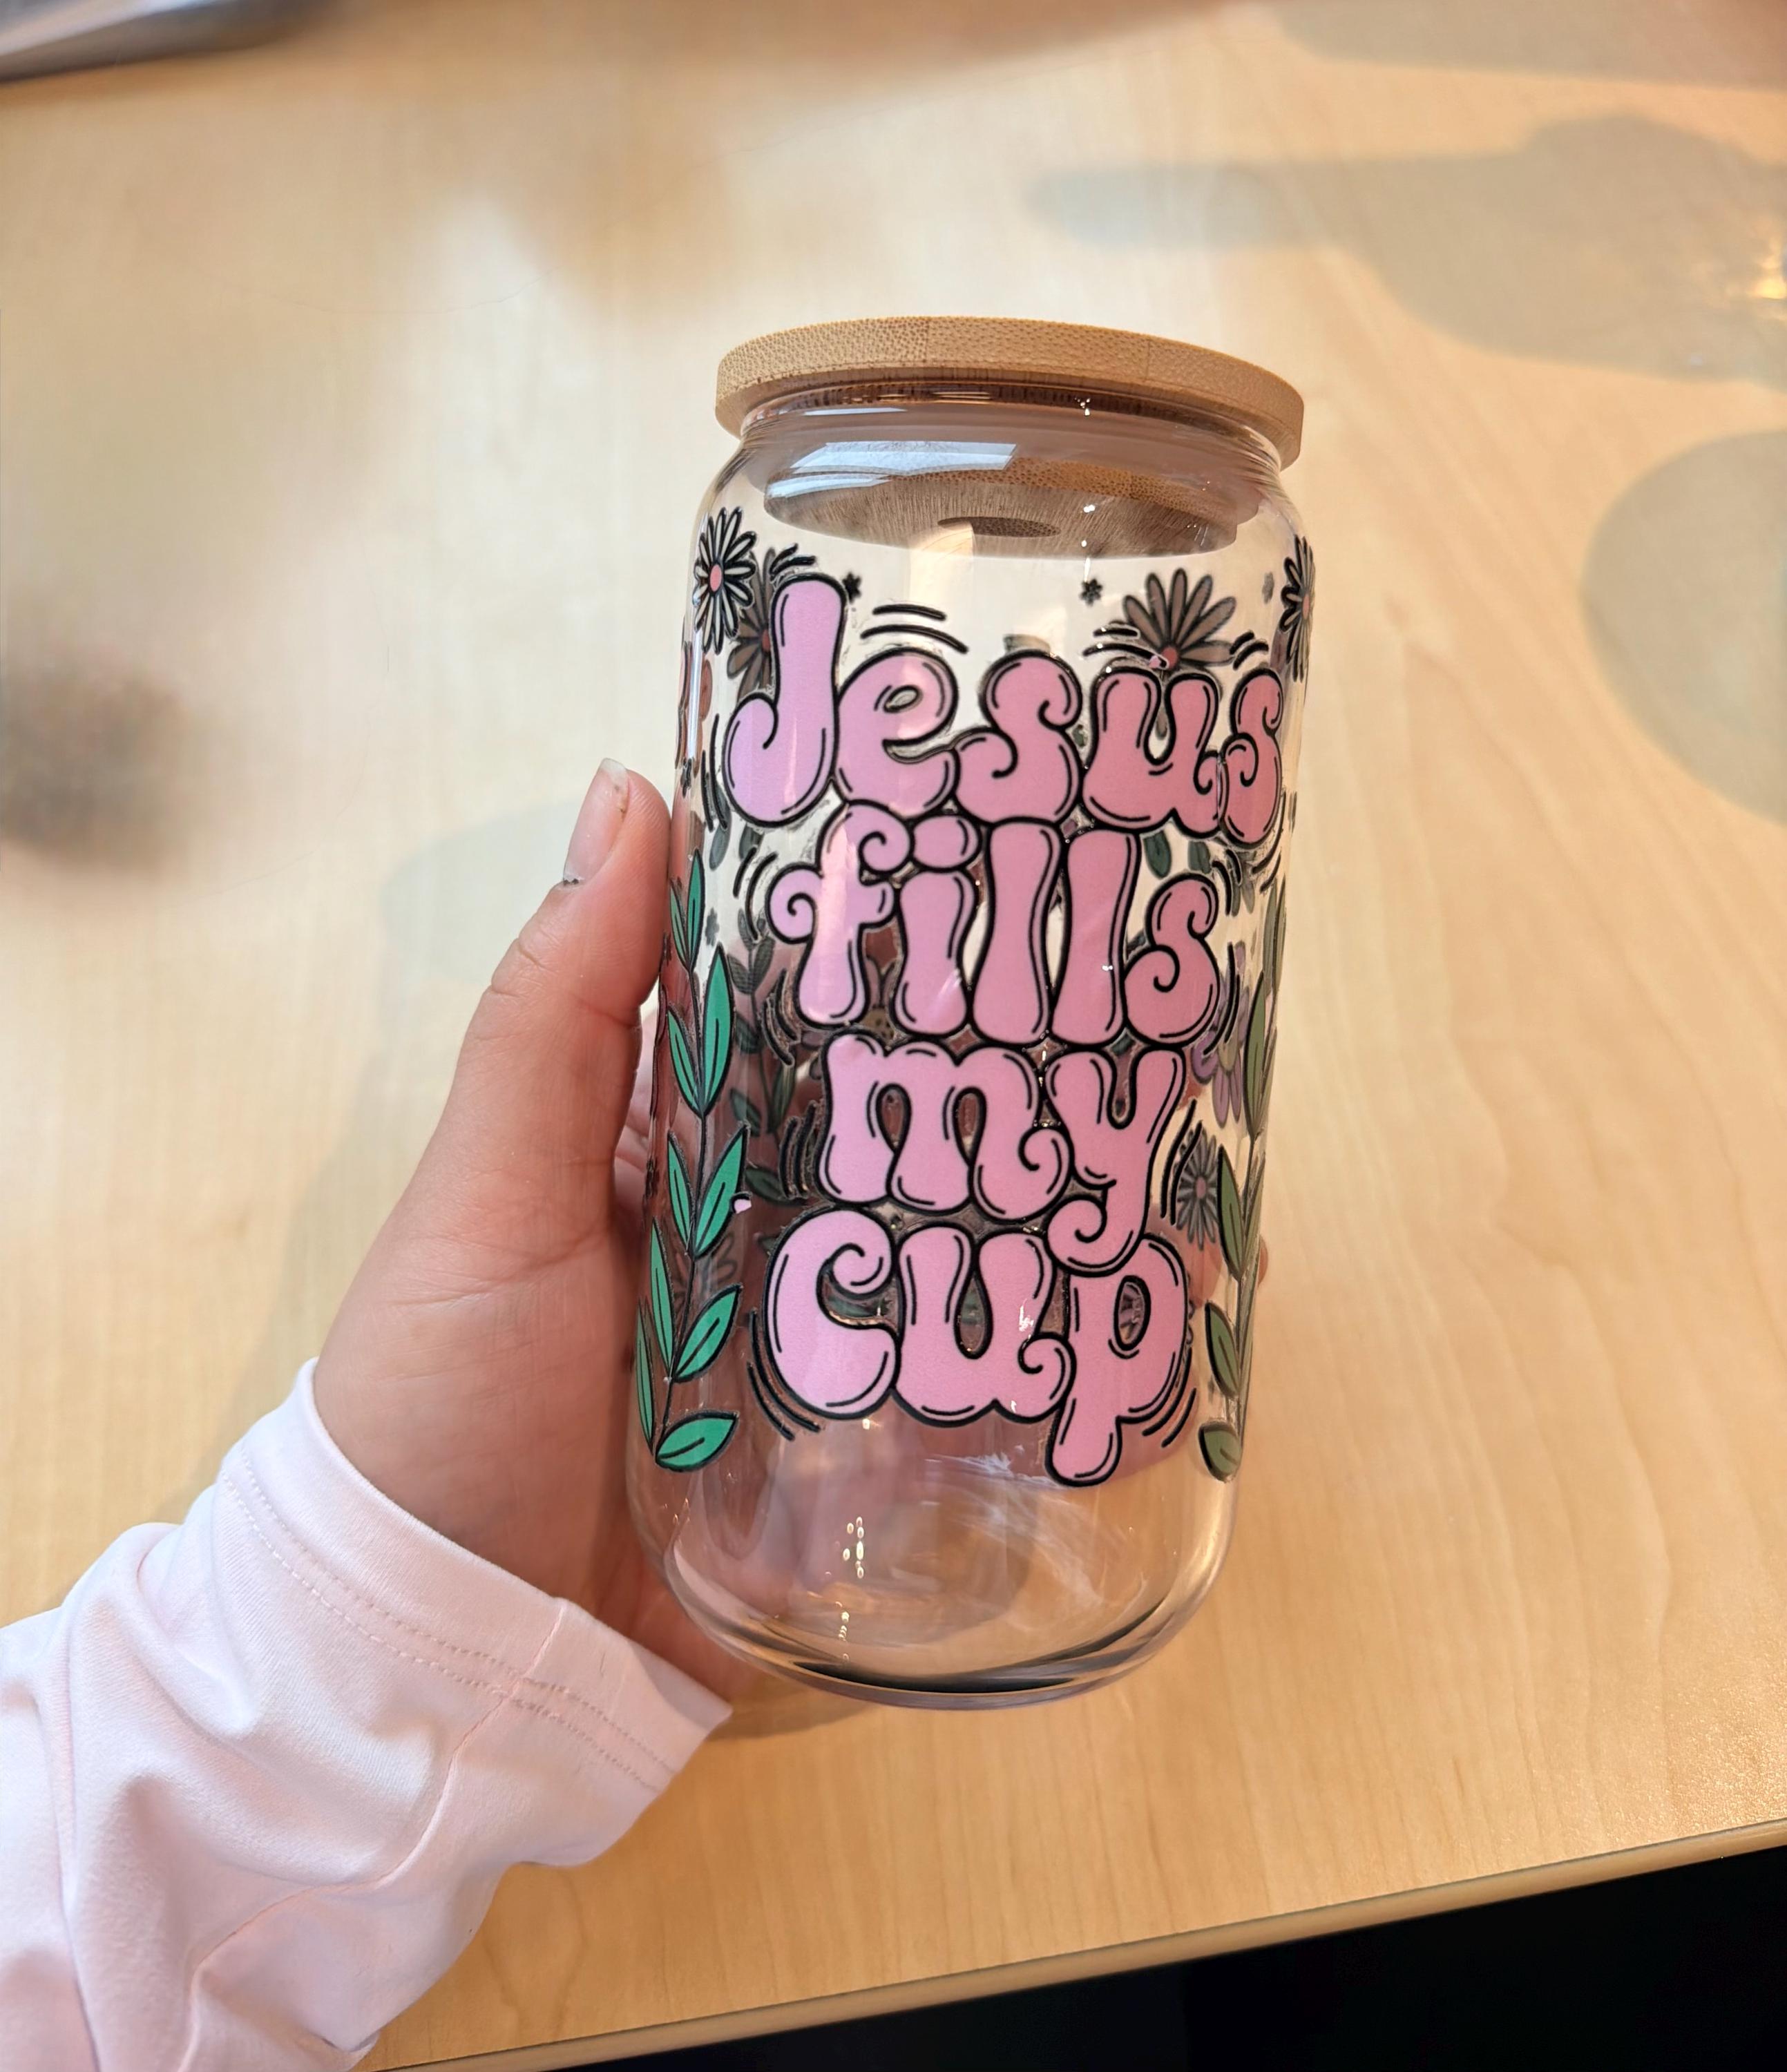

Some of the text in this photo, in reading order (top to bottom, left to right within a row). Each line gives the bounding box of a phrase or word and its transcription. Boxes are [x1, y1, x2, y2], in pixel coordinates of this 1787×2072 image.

[722, 574, 1286, 847] Jesus
[769, 800, 1221, 1047] fills
[819, 1031, 1186, 1269] my
[768, 1209, 1191, 1485] cup
